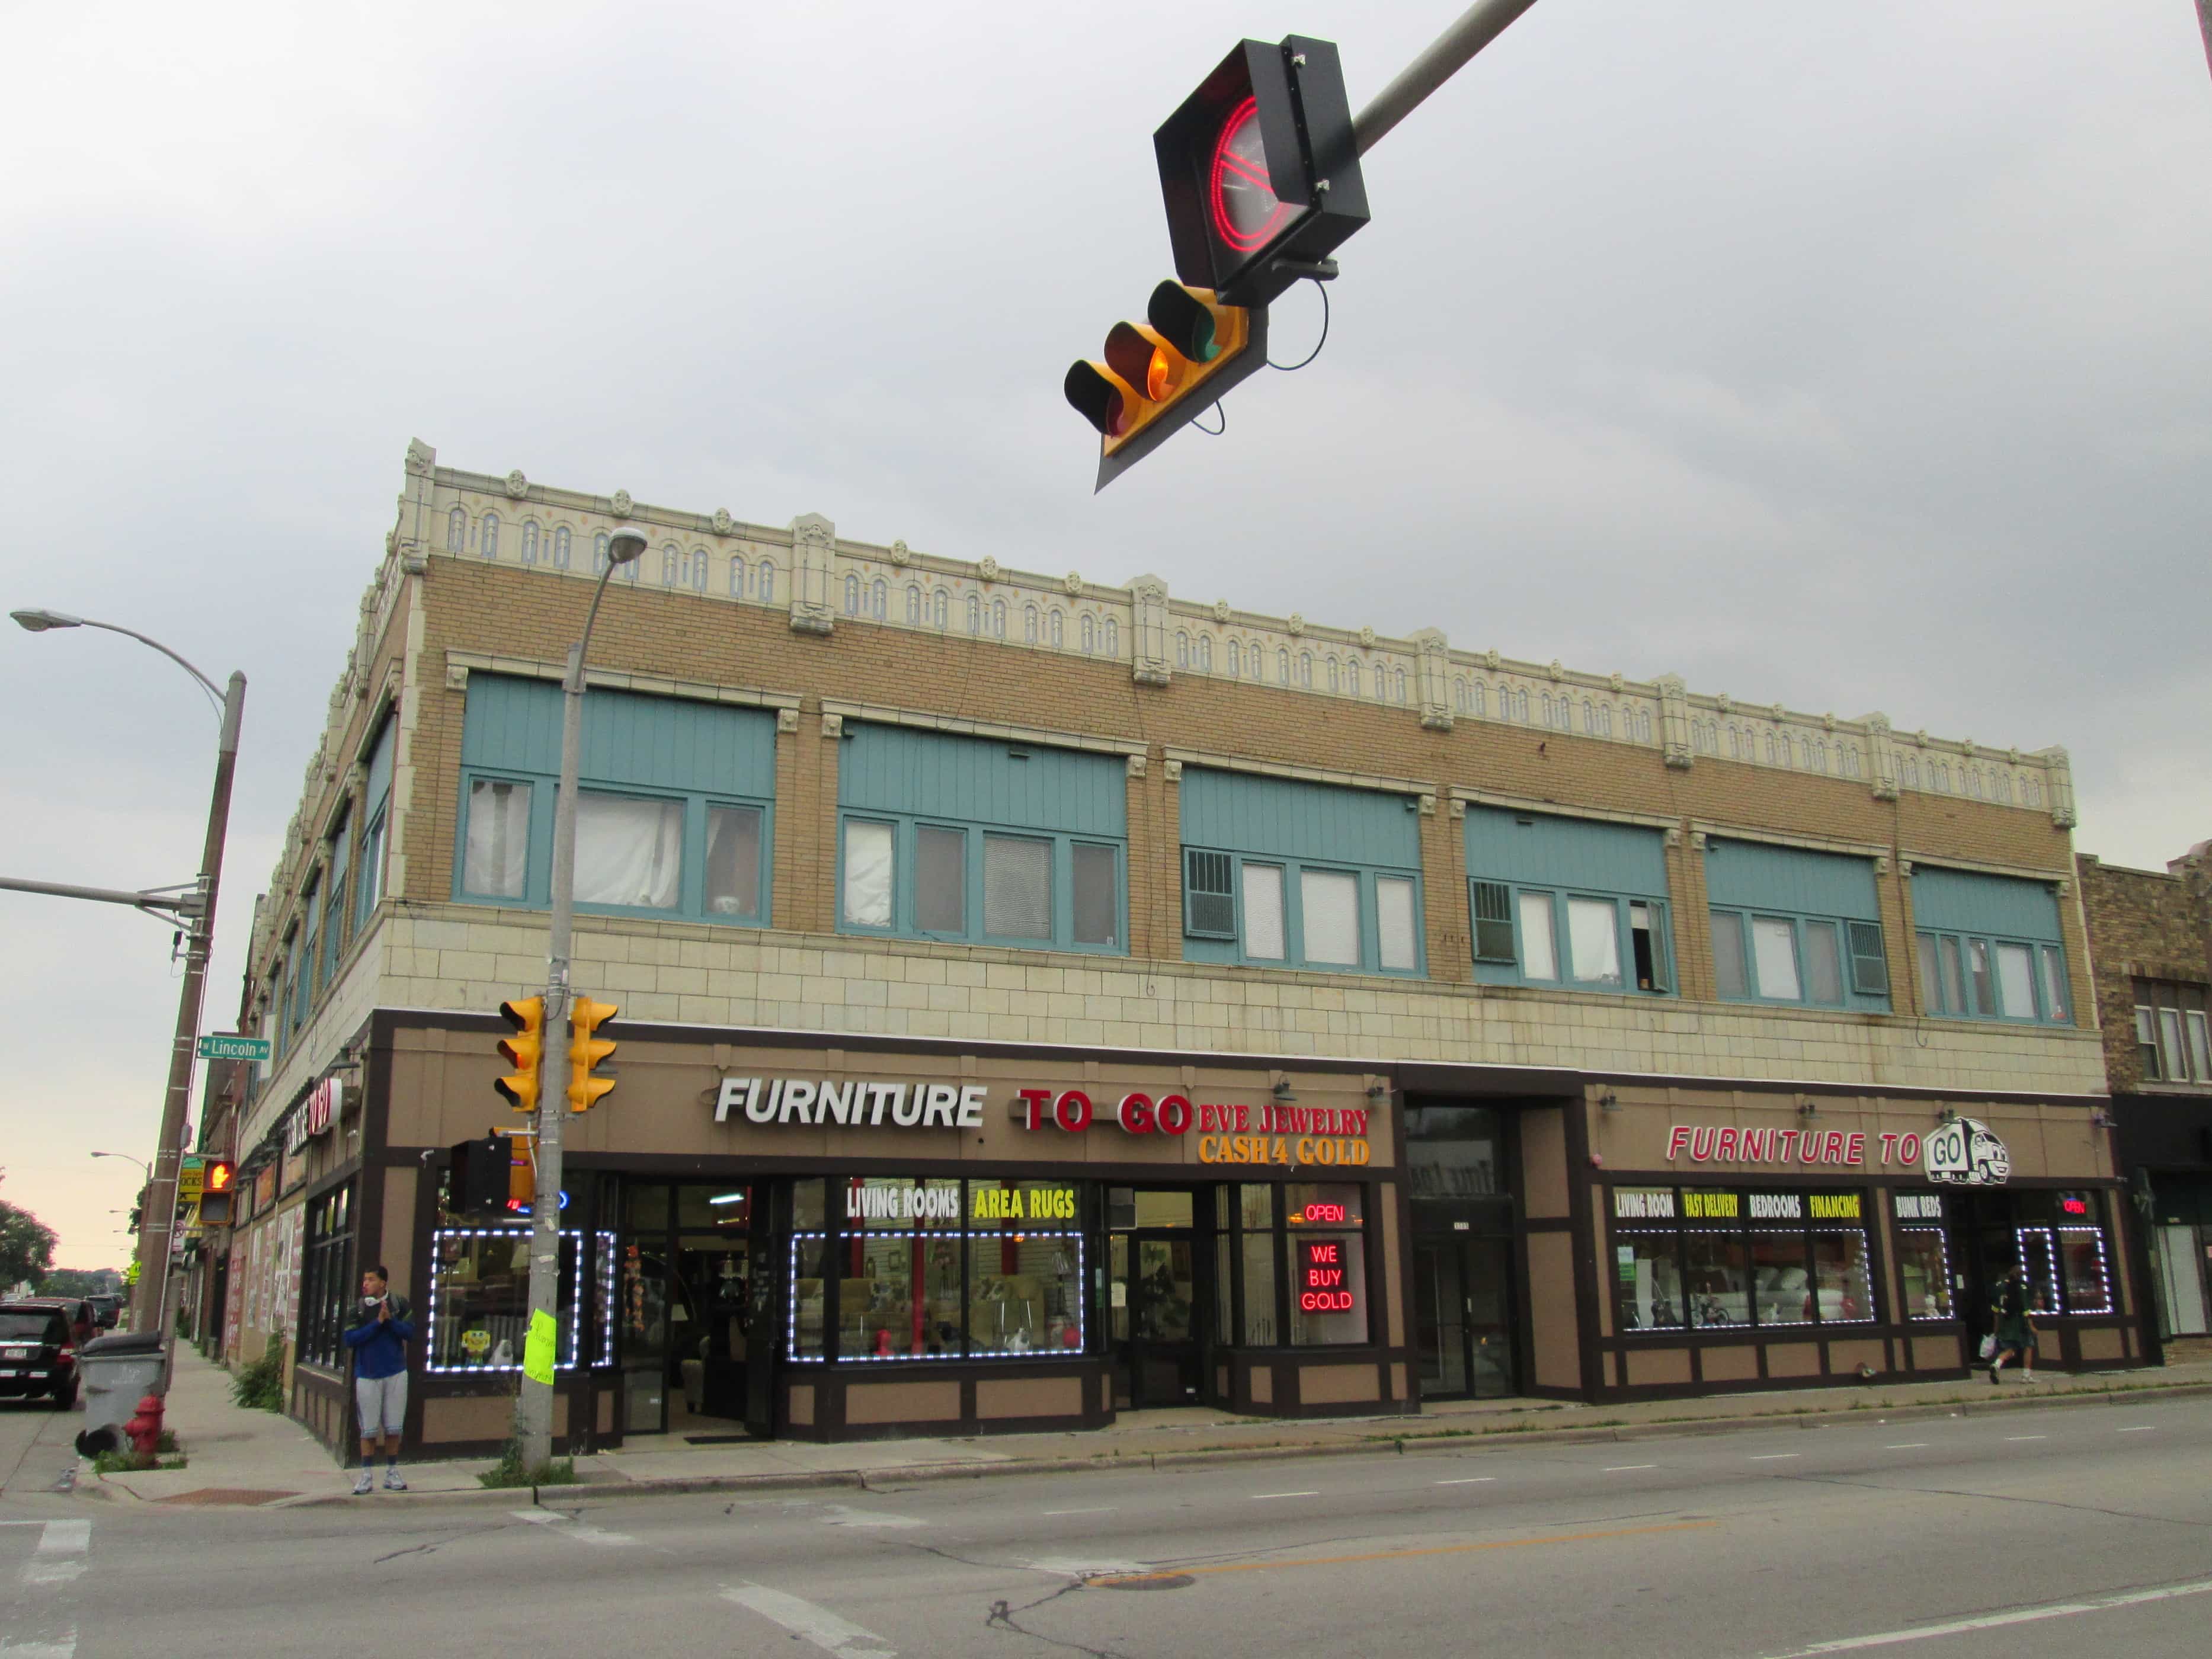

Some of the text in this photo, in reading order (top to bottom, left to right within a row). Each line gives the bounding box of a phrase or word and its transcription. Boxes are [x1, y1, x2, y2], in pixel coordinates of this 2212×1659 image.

[212, 1040, 256, 1056] Lincoln
[715, 1077, 1193, 1136] FURNITURE TO GO
[1198, 1104, 1370, 1135] EVE JEWELRY
[1296, 1138, 1370, 1165] GOLD
[1666, 1125, 1961, 1166] FURNITURE TO GO
[847, 1187, 959, 1218] LIVING ROOMS
[974, 1189, 1075, 1219] AREA RUGS
[1305, 1204, 1345, 1222] OPEN
[1615, 1193, 1675, 1218] LIVING ROOM
[1685, 1194, 1738, 1218] FAST DELIVERY
[1749, 1194, 1801, 1218] BEDROOMS
[1810, 1195, 1861, 1218] FINANCING
[1896, 1194, 1942, 1218] BUNK BEDS
[2063, 1199, 2086, 1214] OPEN
[1311, 1245, 1338, 1263] WE
[1309, 1269, 1342, 1286] BUY
[1301, 1292, 1353, 1310] GOLD
